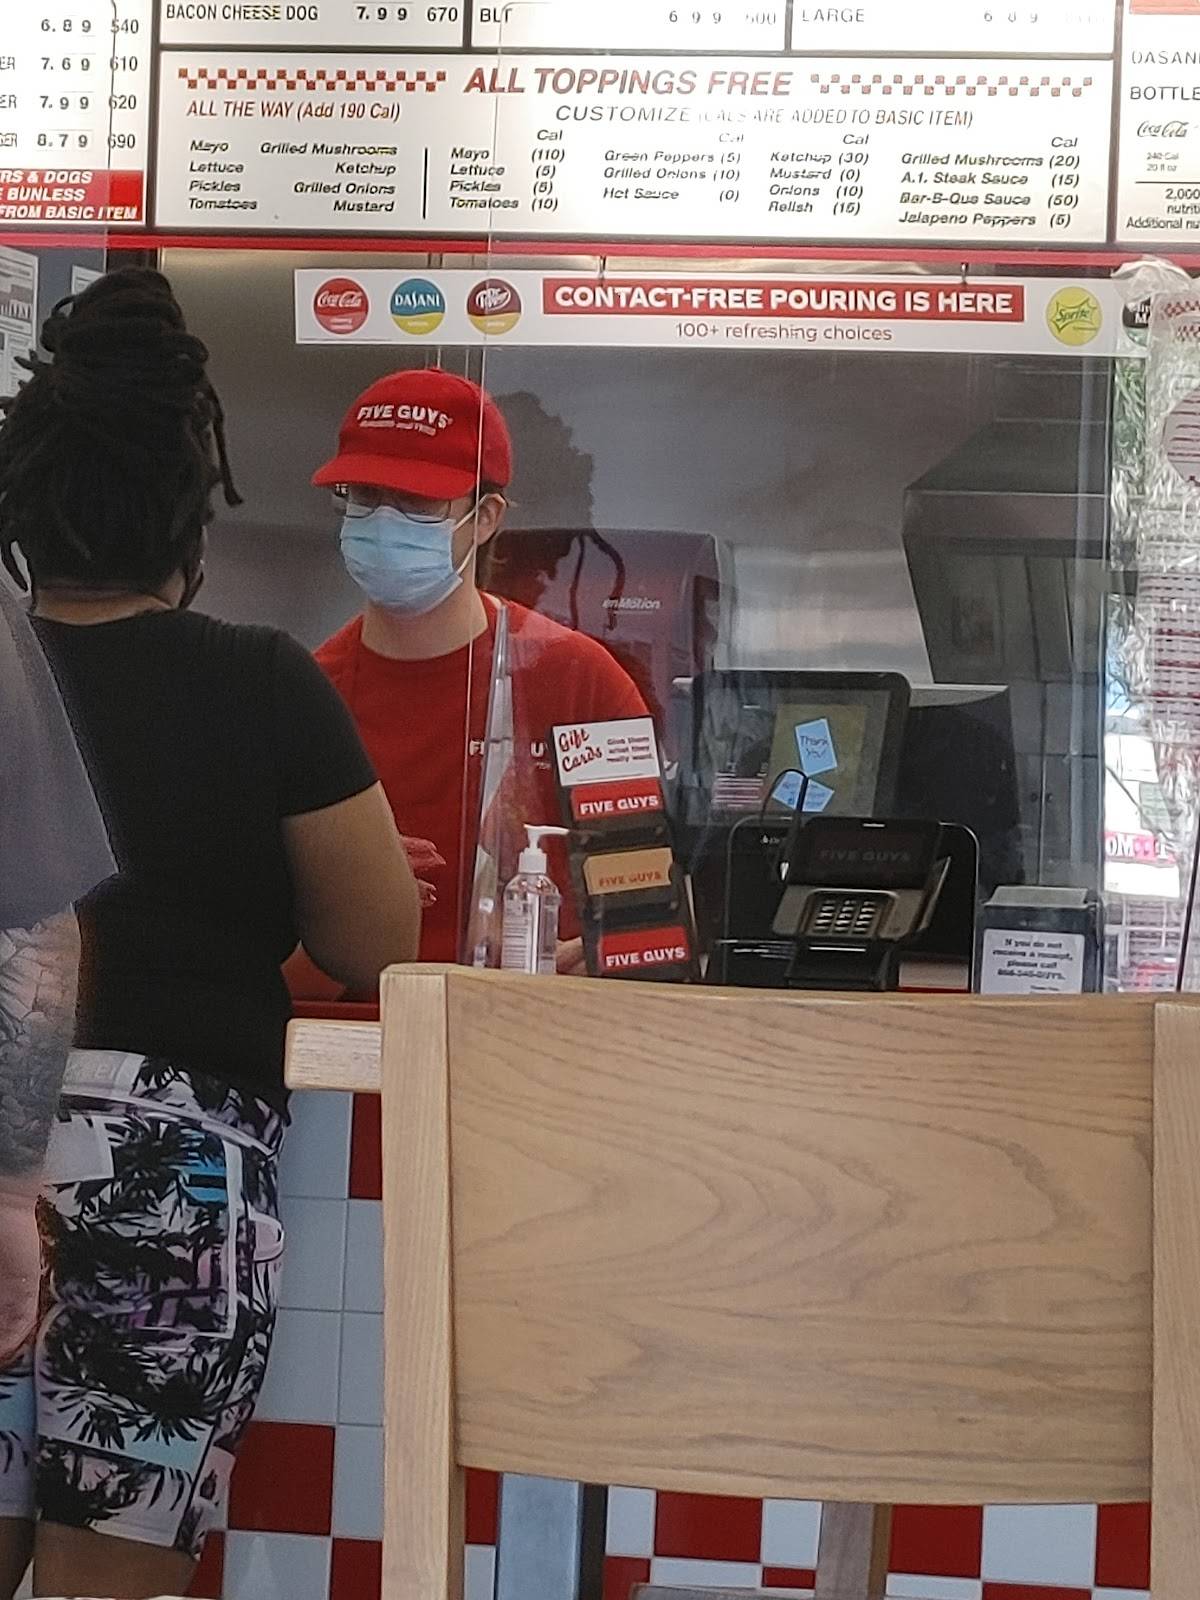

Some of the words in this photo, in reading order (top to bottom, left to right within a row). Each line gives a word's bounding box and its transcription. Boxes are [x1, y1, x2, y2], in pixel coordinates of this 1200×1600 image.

[166, 4, 218, 20] BACON
[222, 5, 281, 21] CHEESE
[286, 6, 319, 21] DOG
[427, 7, 458, 22] 670
[802, 9, 865, 24] LARGE
[110, 18, 140, 34] 540
[109, 56, 139, 71] 610
[464, 67, 525, 94] ALL
[534, 67, 697, 95] TOPPINGS
[708, 71, 794, 96] FREE
[108, 95, 137, 110] 620
[187, 101, 218, 118] ALL
[222, 102, 254, 118] THE
[259, 102, 293, 119] WAY
[296, 101, 334, 121] (Add
[339, 102, 366, 119] 190
[369, 102, 401, 122] Cal)
[556, 104, 691, 122] CUSTOMIZE
[791, 108, 847, 125] ADDED
[850, 109, 871, 125] TO
[875, 109, 926, 126] BASIC
[928, 109, 975, 128] ITEM)
[107, 134, 136, 149] 690
[537, 129, 563, 142] Cal
[843, 132, 870, 145] Cal
[1051, 136, 1078, 149] Cal
[190, 139, 229, 155] Mayo
[260, 141, 307, 155] Grilled
[312, 143, 398, 157] Mushrooms
[450, 148, 490, 161] Mayo
[531, 148, 565, 163] (110)
[604, 150, 648, 163] Green
[654, 151, 715, 164] Peppers
[770, 151, 832, 165] Ketchup
[838, 151, 870, 166] (30)
[901, 153, 950, 167] Grilled
[955, 154, 1044, 168] Mushrooms
[1048, 154, 1080, 169] (20)
[189, 160, 244, 174] Lettuce
[335, 162, 396, 178] Ketchup
[450, 163, 505, 177] Lettuce
[535, 164, 556, 179] (5)
[604, 167, 652, 180] Grilled
[656, 168, 707, 181] Onions
[713, 168, 741, 182] (10)
[26, 171, 39, 184] &
[43, 170, 93, 184] DOGS
[769, 168, 832, 181] Mustard
[839, 168, 861, 183] (0)
[901, 172, 928, 185] A.1.
[933, 171, 976, 185] Steak
[981, 171, 1028, 186] Sauce
[1051, 173, 1080, 188] (15)
[189, 180, 241, 193] Pickles
[293, 181, 339, 195] Grilled
[343, 181, 396, 196] Onions
[450, 180, 502, 193] Pickles
[533, 180, 553, 196] (5)
[768, 184, 821, 197] Onions
[836, 185, 864, 200] (10)
[7, 188, 86, 202] BUNLESS
[604, 188, 630, 200] Hot
[634, 189, 680, 201] Sauce
[719, 189, 740, 203] (0)
[984, 193, 1031, 207] Sauce
[1047, 194, 1079, 209] (50)
[188, 197, 257, 211] Tomatoes
[333, 199, 395, 213] Mustard
[450, 197, 519, 210] Tomatoes
[531, 198, 559, 212] (10)
[768, 201, 814, 214] Relish
[0, 205, 41, 219] FROM
[45, 206, 95, 220] BASIC
[98, 206, 138, 220] ITEM
[898, 211, 968, 226] Jalapeno
[972, 213, 1037, 228] Peppers
[1049, 213, 1071, 228] (5)
[1126, 216, 1182, 229] Additional
[395, 290, 440, 309] DASANI
[555, 286, 763, 309] CONTACT-FREE
[770, 288, 896, 312] POURING
[904, 290, 931, 312] IS
[938, 291, 1013, 313] HERE
[1056, 307, 1090, 322] Sprite
[675, 322, 719, 338] 100+
[726, 322, 818, 342] refreshing
[823, 325, 893, 341] choices
[357, 404, 395, 420] FIVE
[397, 404, 449, 429] GUYS
[559, 727, 590, 752] Gift
[562, 745, 603, 772] Cards
[579, 801, 613, 816] FIVE
[617, 795, 659, 810] GUYS
[599, 875, 625, 888] FIVE
[628, 871, 663, 884] GUYS
[605, 953, 639, 967] FIVE
[643, 946, 686, 962] GUYS
